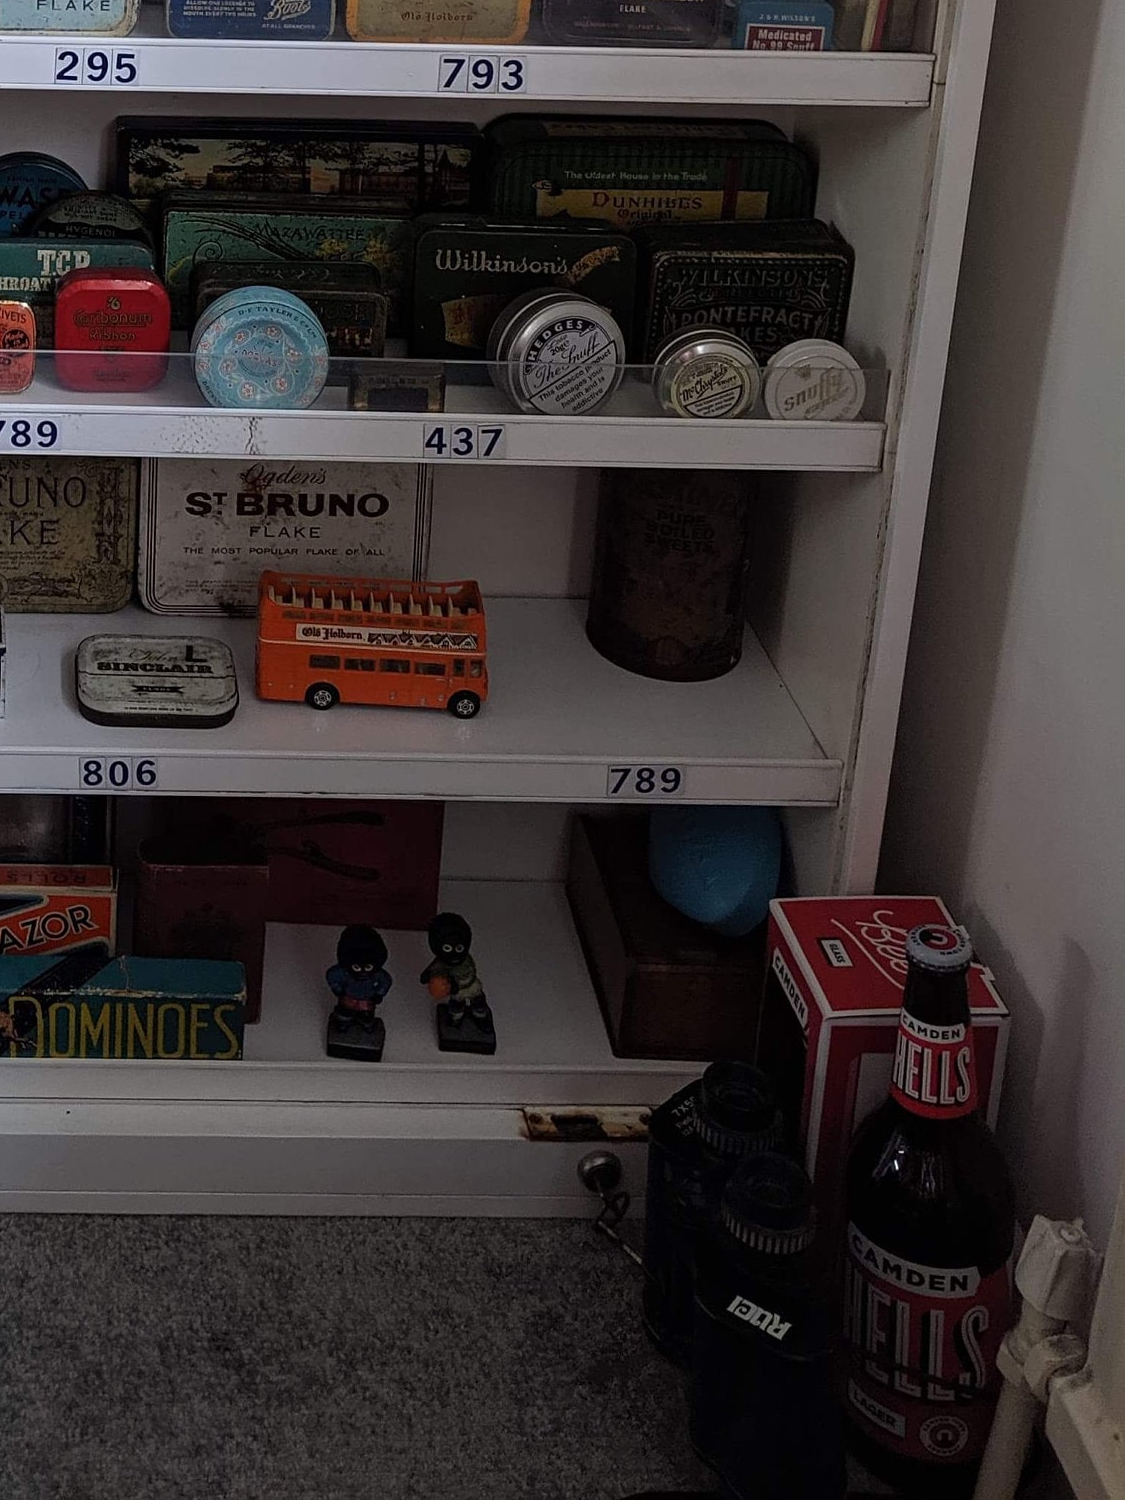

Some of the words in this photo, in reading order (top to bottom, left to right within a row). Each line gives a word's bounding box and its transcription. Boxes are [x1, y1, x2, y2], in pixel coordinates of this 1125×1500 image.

[36, 0, 111, 11] FLAKE
[619, 4, 646, 13] FLAKE
[758, 28, 812, 42] Medicated
[56, 51, 137, 83] 295
[441, 58, 524, 90] 793
[436, 248, 568, 275] Wilkinson's
[256, 306, 293, 318] TAYLER
[681, 305, 822, 331] PONTEFRACT
[527, 319, 584, 364] HEDGES
[425, 426, 503, 456] 437
[236, 493, 389, 518] BRUNO
[249, 526, 322, 539] FLAKE
[97, 661, 214, 675] SINCLAIR
[82, 758, 157, 787] 806
[609, 766, 682, 793] 789
[775, 954, 807, 1019] CAMDEN
[9, 996, 241, 1060] DOMINOES
[903, 1016, 961, 1039] CAMDEN
[893, 1035, 971, 1106] HELLS
[853, 1233, 969, 1293] CAMDEN
